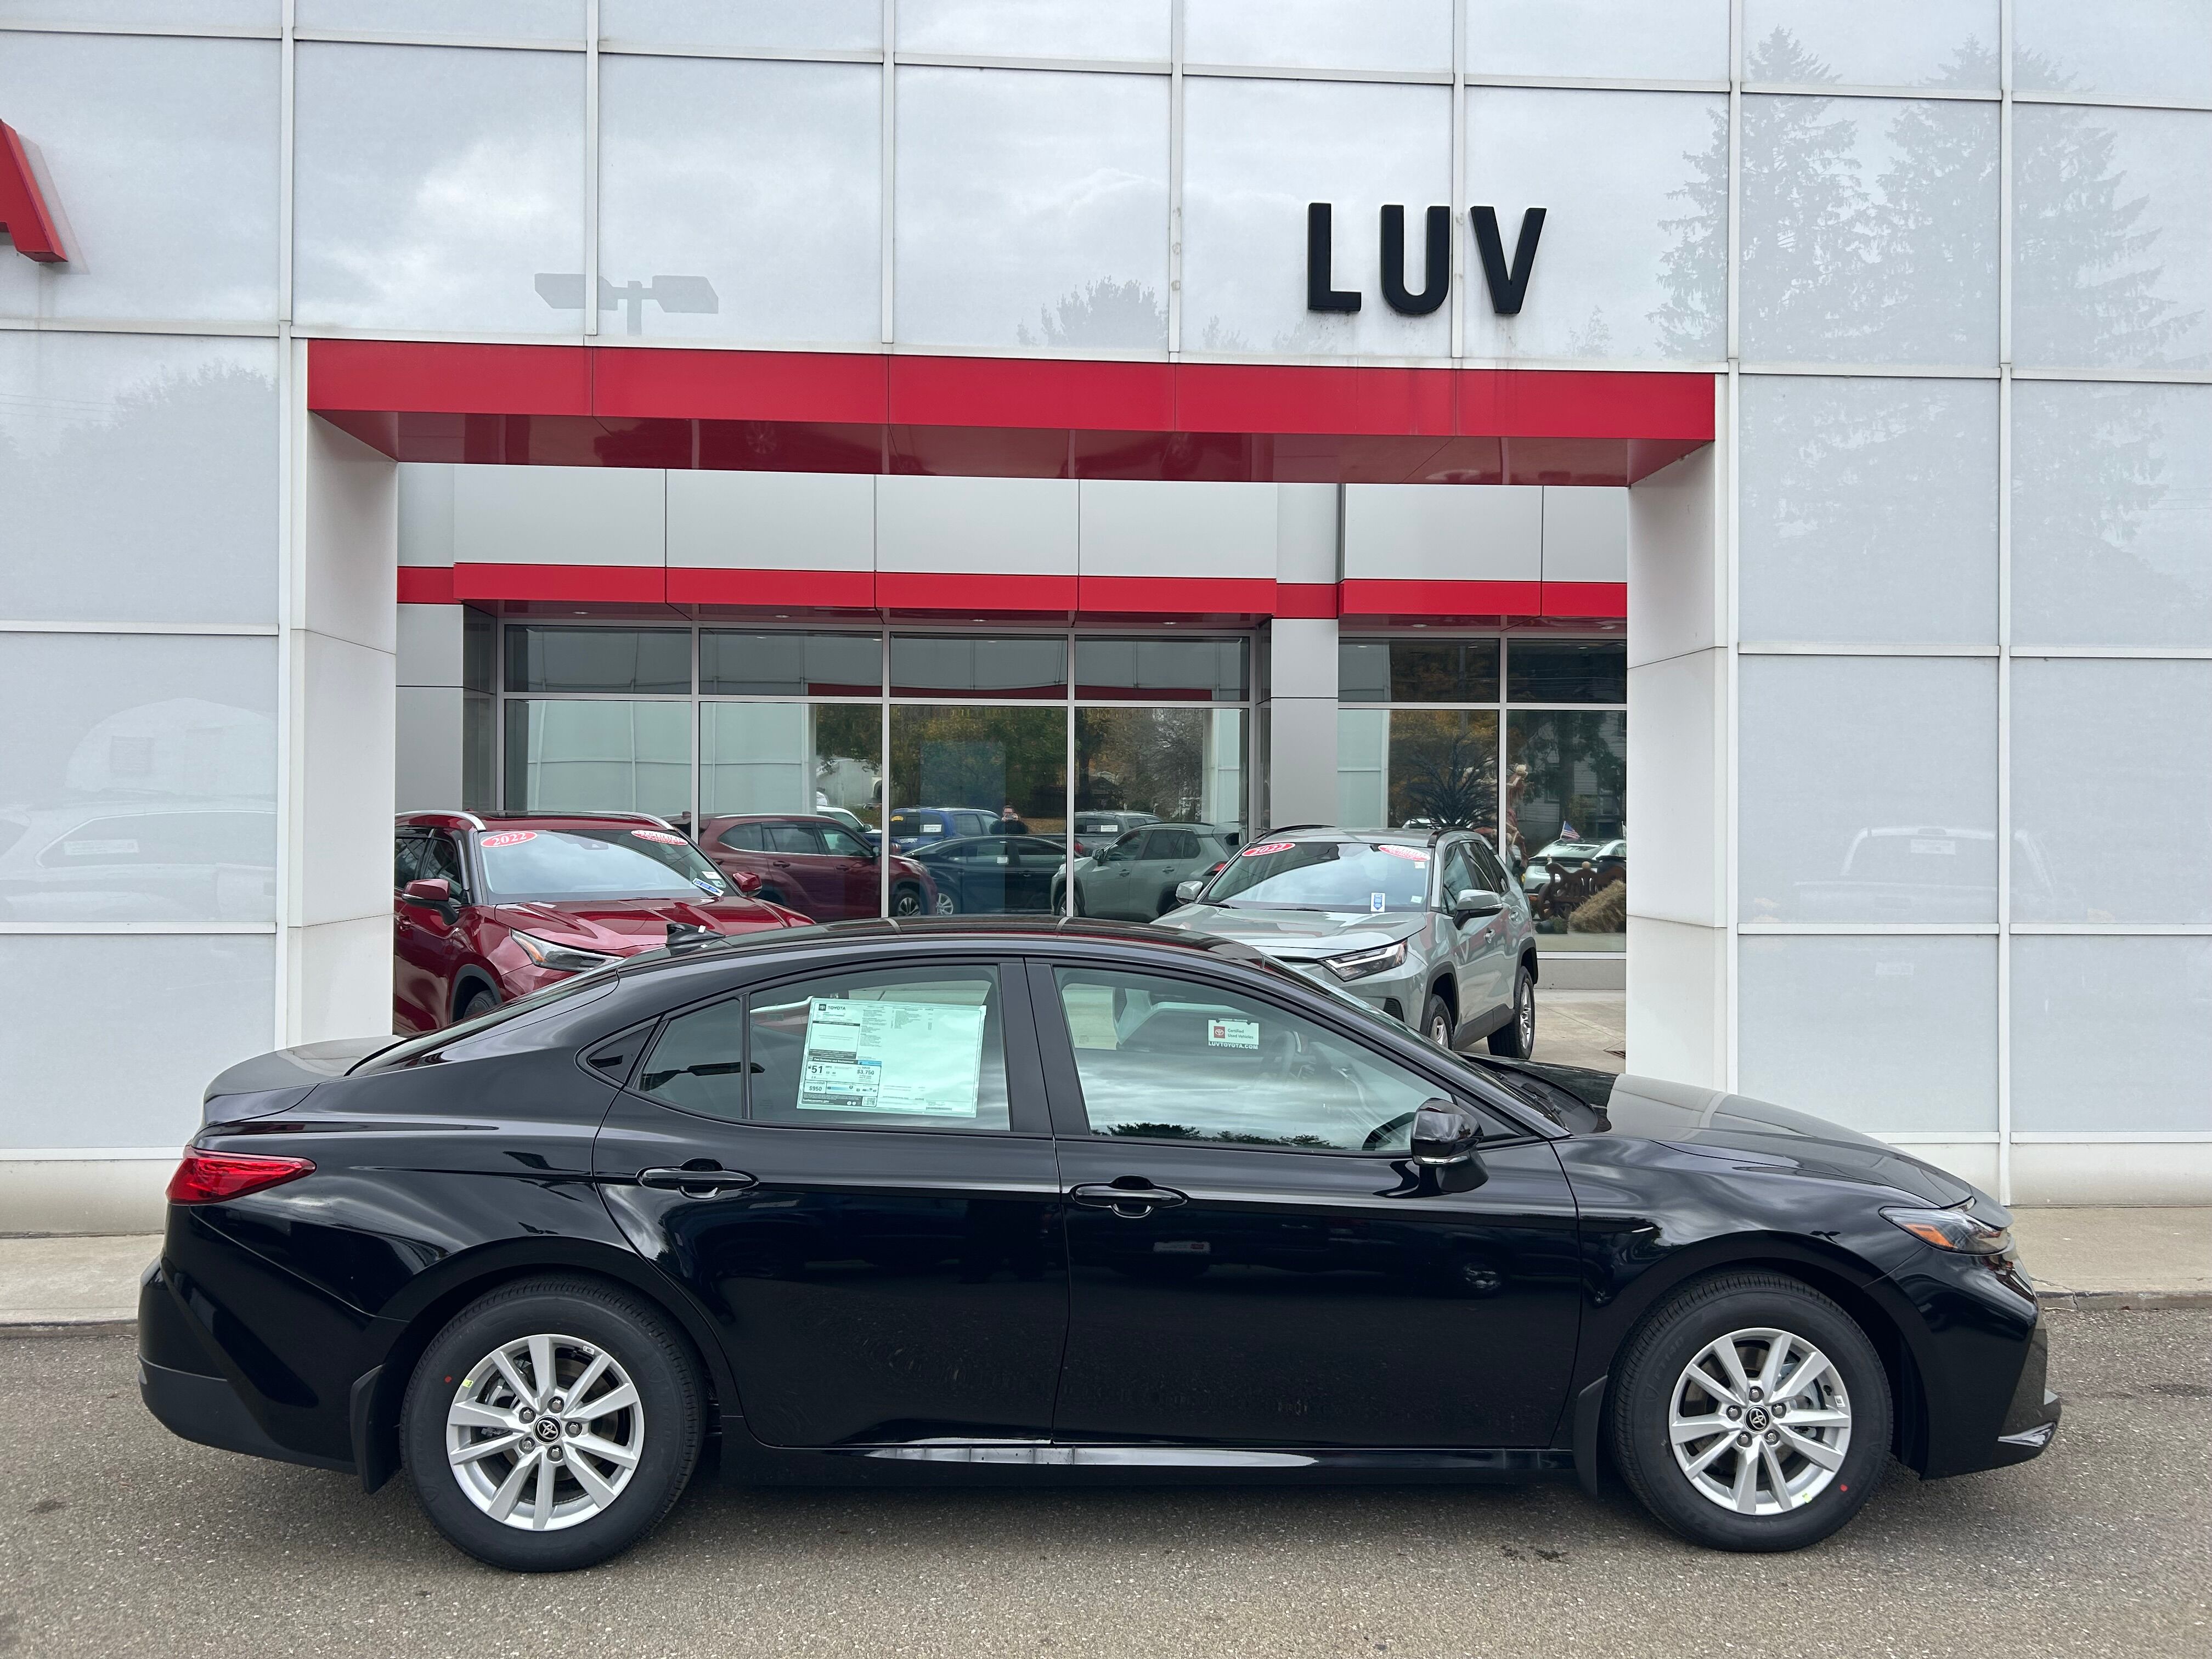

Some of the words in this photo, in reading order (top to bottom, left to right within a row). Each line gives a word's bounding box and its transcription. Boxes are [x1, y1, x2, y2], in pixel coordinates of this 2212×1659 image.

[1308, 202, 1548, 316] LUV
[492, 832, 527, 846] 2022
[1249, 844, 1286, 855] 2022
[1208, 1041, 1259, 1049] LUVTOYOTA.COM
[811, 1065, 823, 1074] 51
